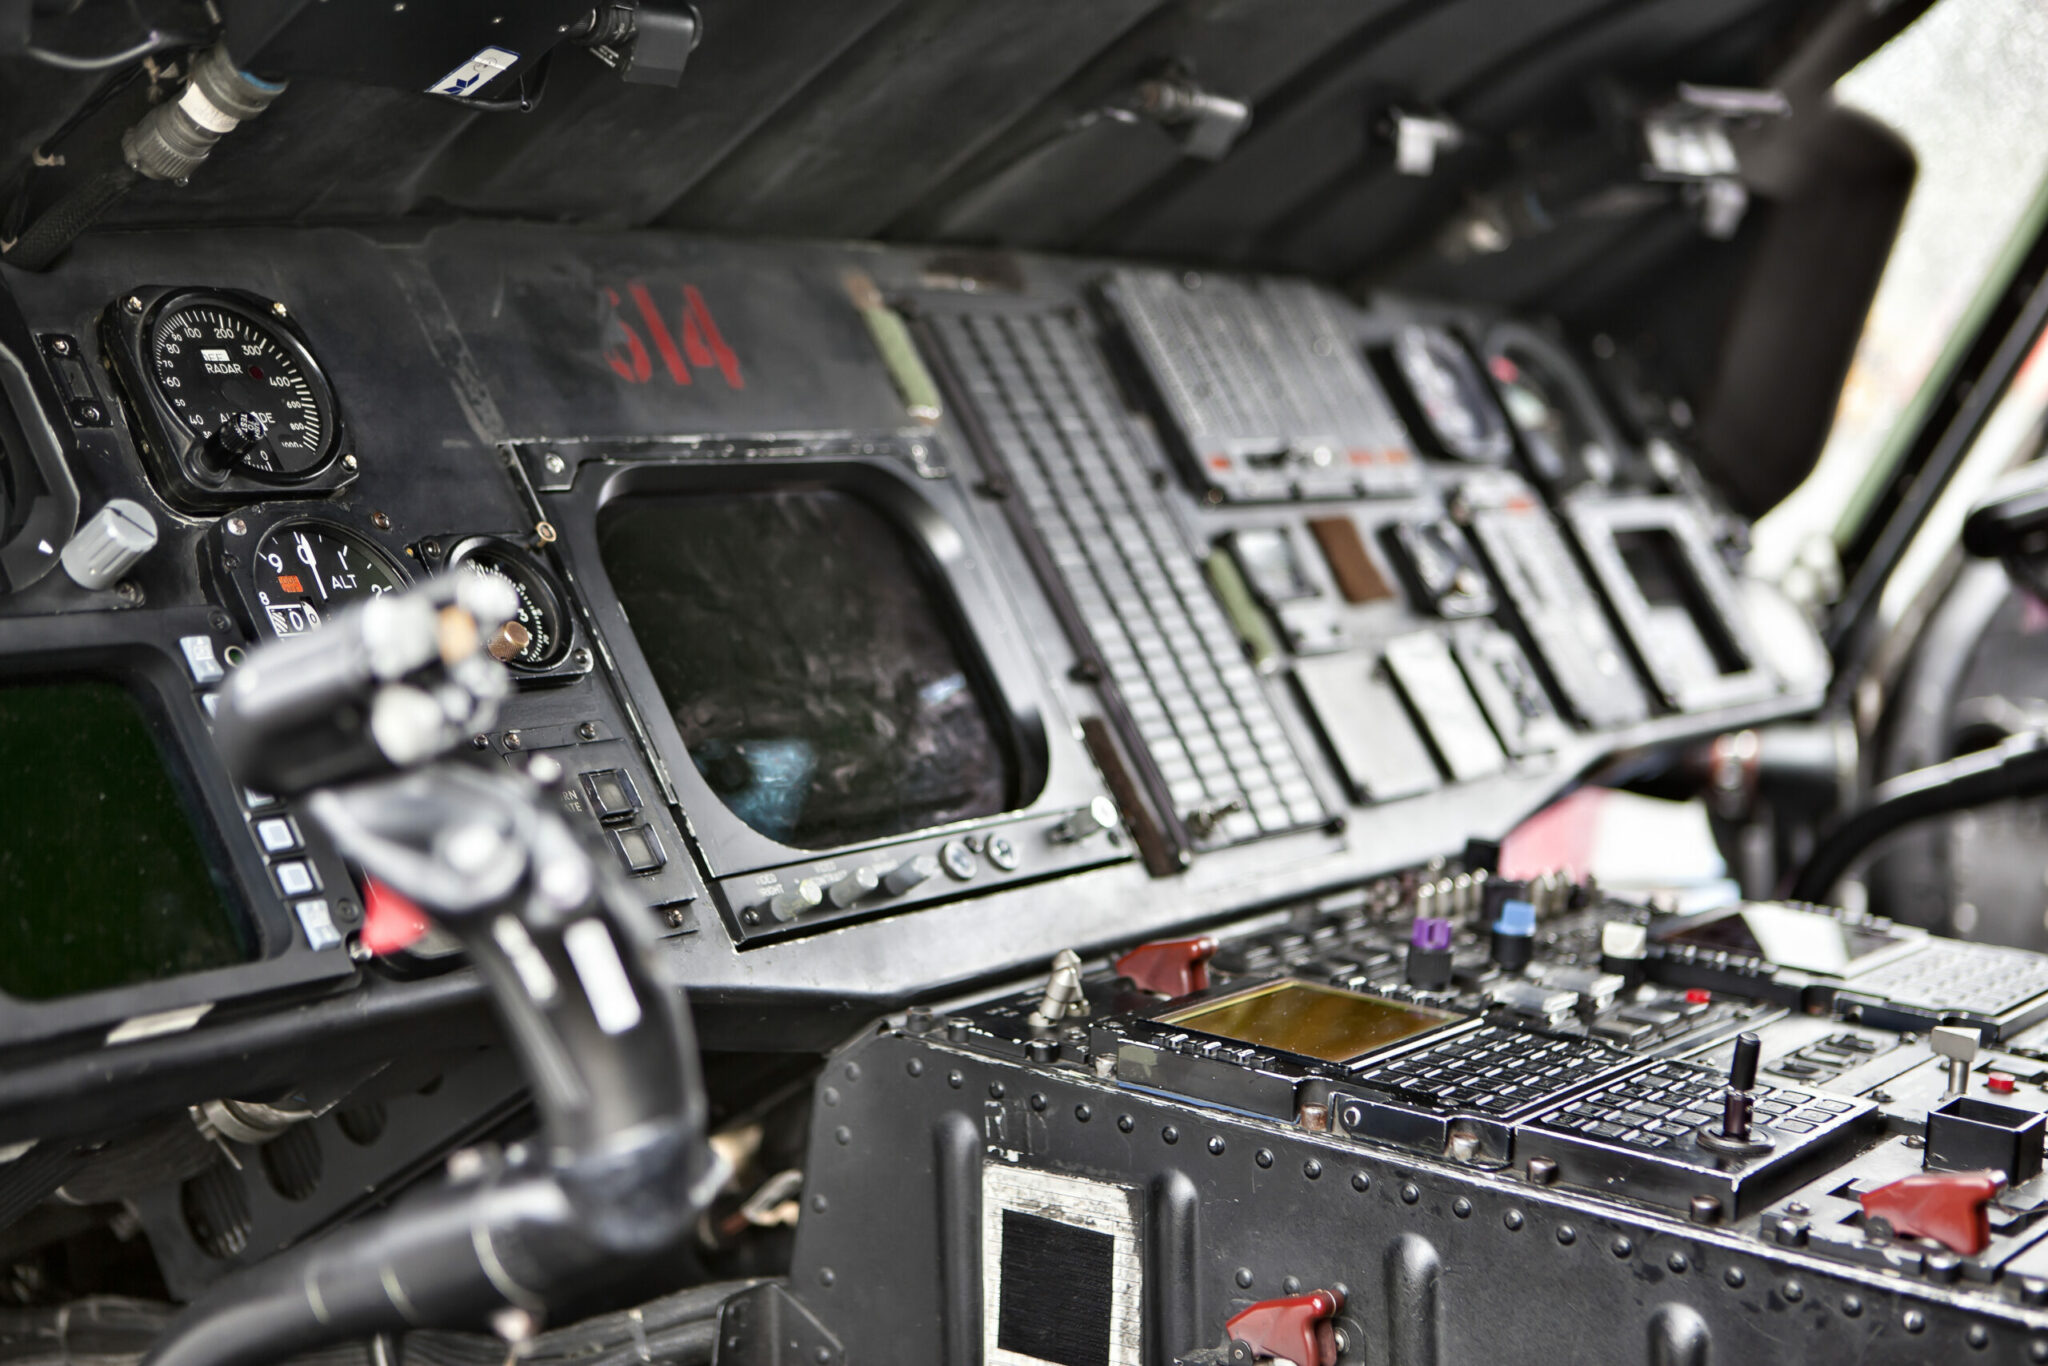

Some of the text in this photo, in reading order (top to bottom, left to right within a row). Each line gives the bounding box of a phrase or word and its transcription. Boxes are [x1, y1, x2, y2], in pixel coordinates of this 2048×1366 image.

[171, 333, 183, 341] 90
[184, 328, 202, 338] 100
[214, 328, 234, 339] 200
[165, 343, 180, 354] 80
[241, 345, 262, 356] 300
[163, 360, 174, 368] 70
[205, 363, 243, 374] RADAR
[166, 376, 181, 387] 60
[269, 376, 291, 387] 400
[286, 400, 301, 409] 600
[189, 414, 204, 425] 40
[240, 413, 248, 433] TEST
[290, 422, 304, 431] 800
[260, 450, 269, 461] 0
[267, 553, 284, 574] 9
[331, 574, 358, 590] ALT
[258, 591, 270, 606] 8
